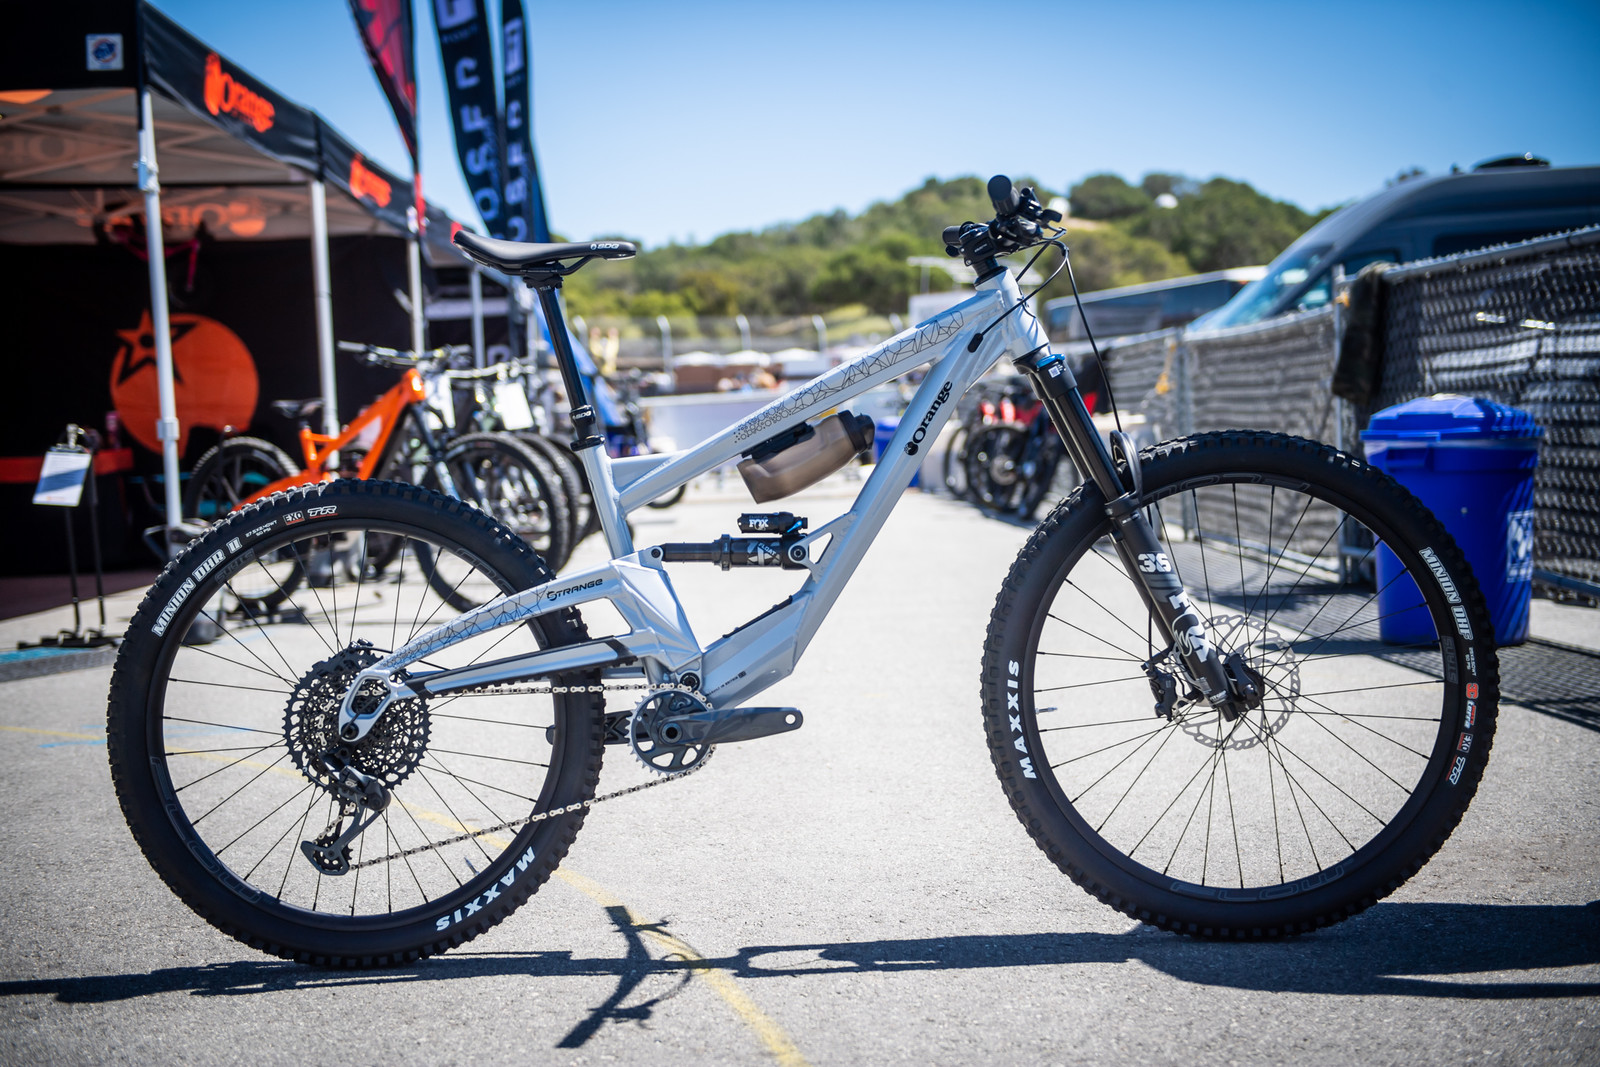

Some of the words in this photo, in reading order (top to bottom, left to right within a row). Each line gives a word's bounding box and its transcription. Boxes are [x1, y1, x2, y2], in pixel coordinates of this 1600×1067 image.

[913, 381, 953, 444] Orange
[284, 511, 303, 522] EXO
[307, 505, 337, 517] TR
[749, 519, 769, 531] FOX
[758, 542, 777, 556] FLOAT
[1137, 553, 1172, 573] 36
[152, 577, 196, 637] MINION
[192, 549, 226, 582] DHR
[226, 537, 242, 554] II
[547, 578, 603, 601] STRANGE
[1419, 547, 1461, 604] MINION
[1451, 605, 1474, 641] DHF
[1466, 683, 1479, 699] 3C
[1007, 660, 1037, 778] MAXXIS
[1460, 733, 1472, 752] EXO
[1449, 756, 1466, 785] TR
[436, 846, 536, 931] MAXXIS
